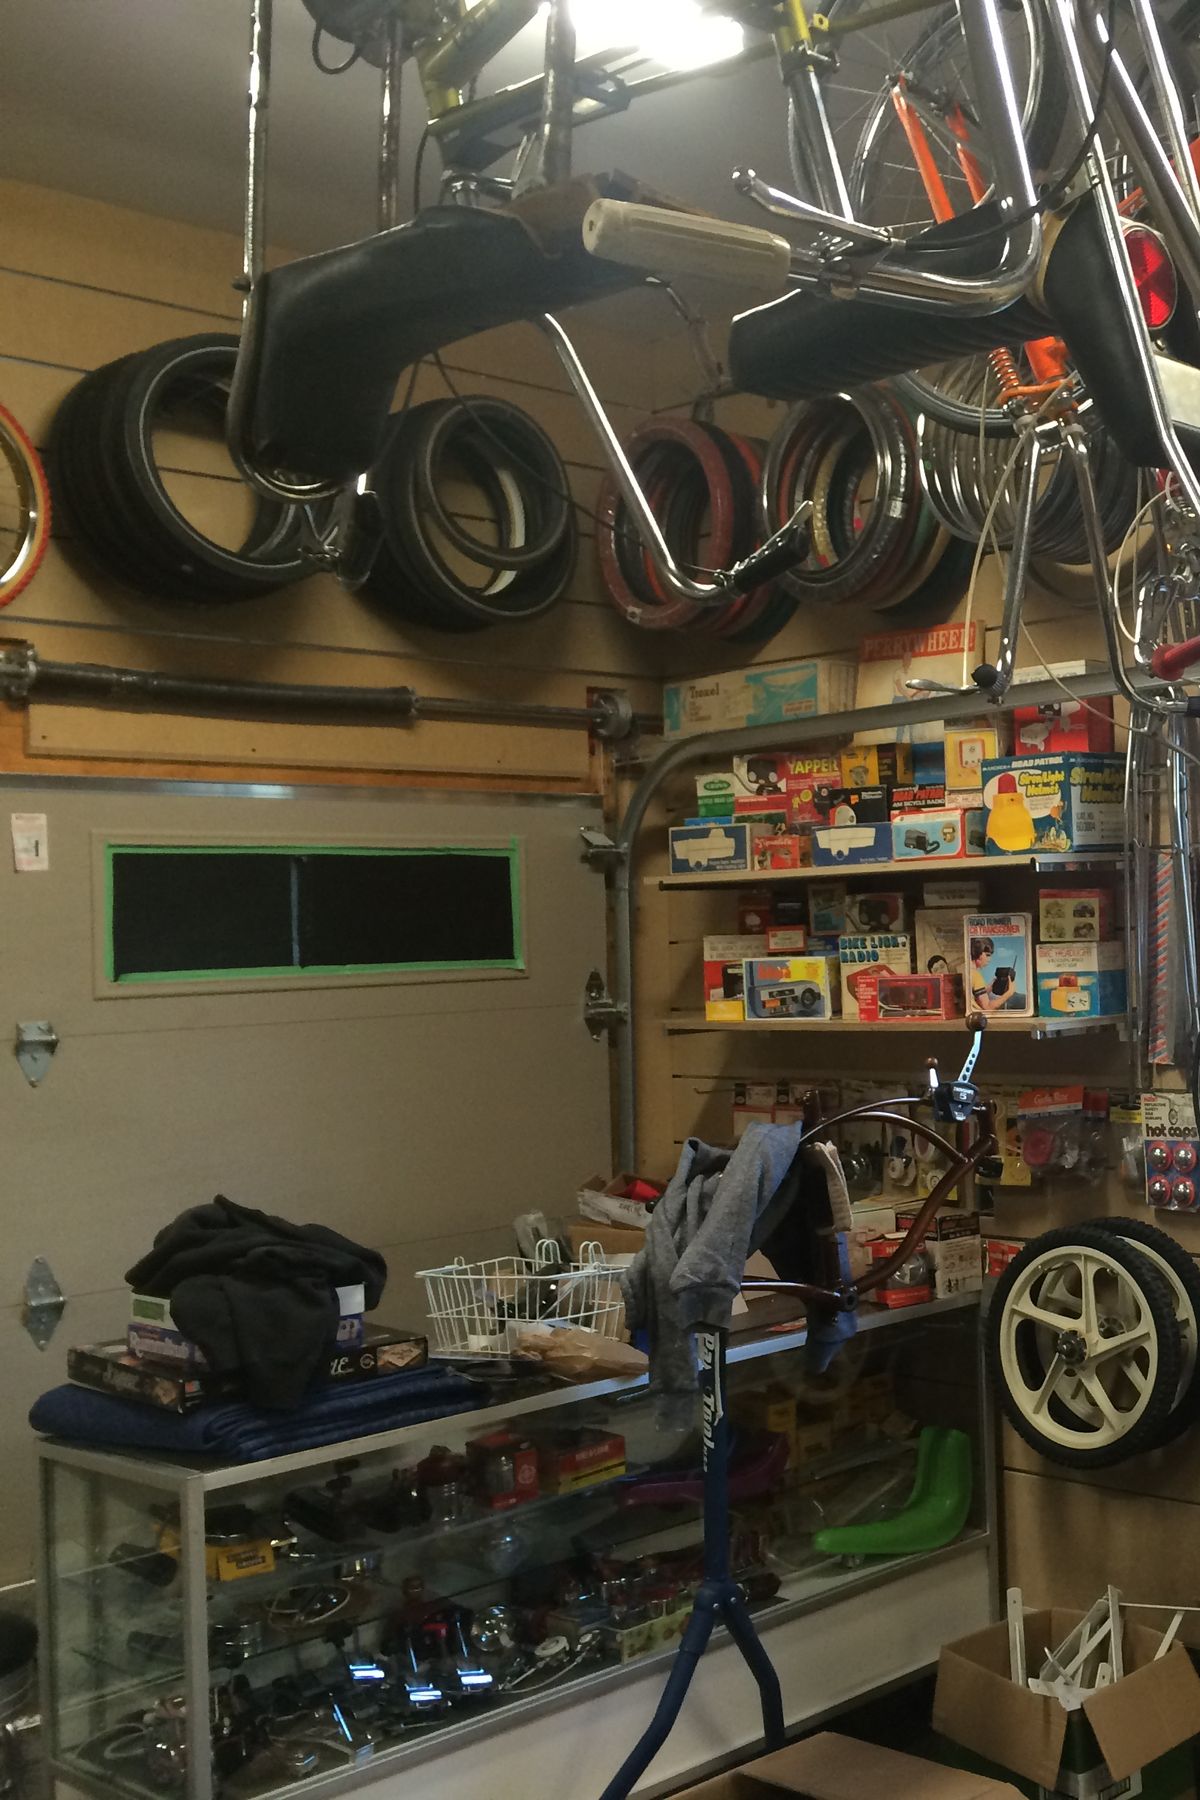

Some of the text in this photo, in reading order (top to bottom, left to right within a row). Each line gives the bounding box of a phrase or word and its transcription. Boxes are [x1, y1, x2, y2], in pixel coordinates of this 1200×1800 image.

[787, 756, 839, 775] YAPPER
[840, 936, 868, 950] BIKE
[840, 950, 879, 963] RADIO
[1145, 1123, 1198, 1140] hot caps
[702, 1393, 716, 1450] Tool
